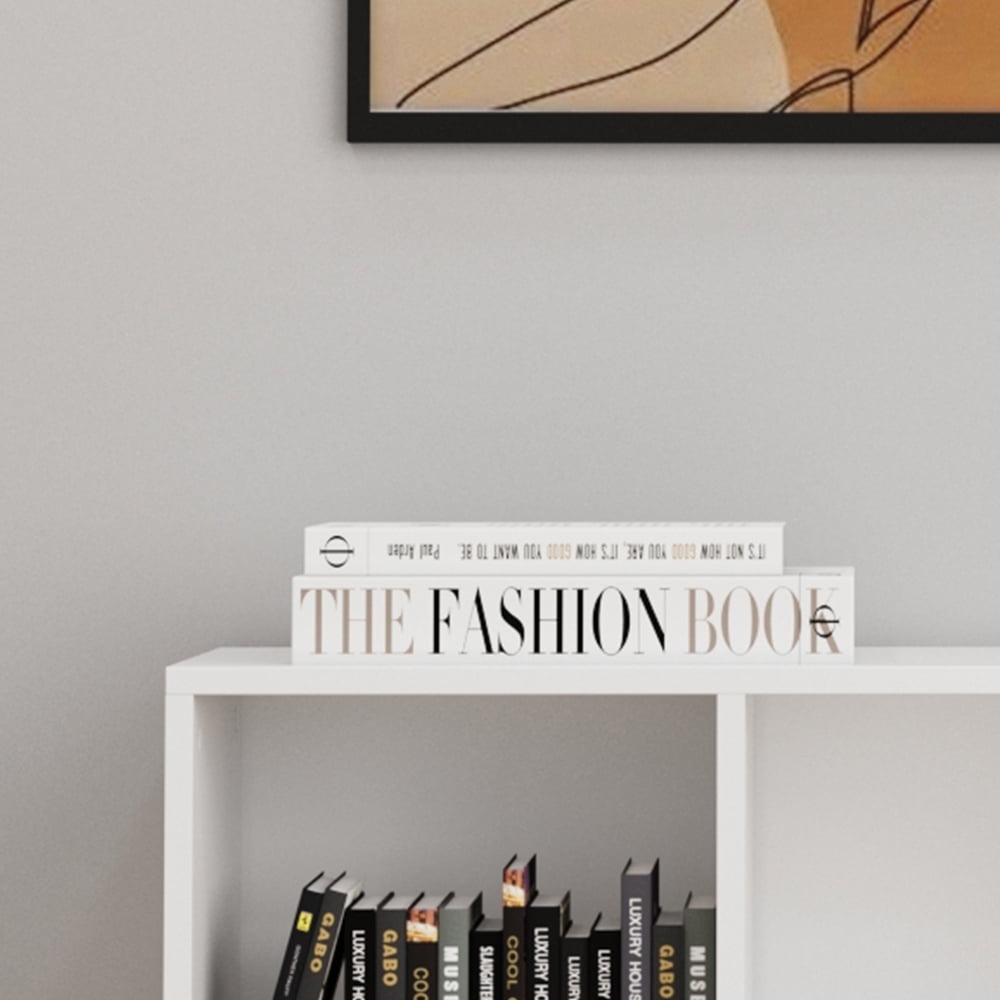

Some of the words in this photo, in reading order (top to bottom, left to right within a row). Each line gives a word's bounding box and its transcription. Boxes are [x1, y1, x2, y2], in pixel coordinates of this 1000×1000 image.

[387, 543, 415, 560] Arden
[419, 543, 441, 560] Paul
[477, 543, 489, 560] TO
[492, 543, 520, 560] WANT
[523, 543, 543, 560] YOU
[575, 543, 598, 560] HOW
[600, 543, 619, 560] IT'S
[648, 543, 667, 560] YOU
[700, 543, 722, 560] HOW
[725, 543, 745, 560] NOT
[747, 543, 767, 560] IT'S
[300, 586, 415, 656] THE
[428, 585, 672, 657] FASHION
[684, 585, 843, 657] BOOK
[628, 897, 642, 957] LUXURY
[310, 912, 336, 974] GABO
[351, 929, 366, 983] LUXURY
[382, 929, 398, 987] GABO
[506, 935, 519, 990] COOL
[534, 927, 549, 981] LUXURY
[598, 949, 611, 1000] LUXURY
[659, 944, 674, 999] GABO
